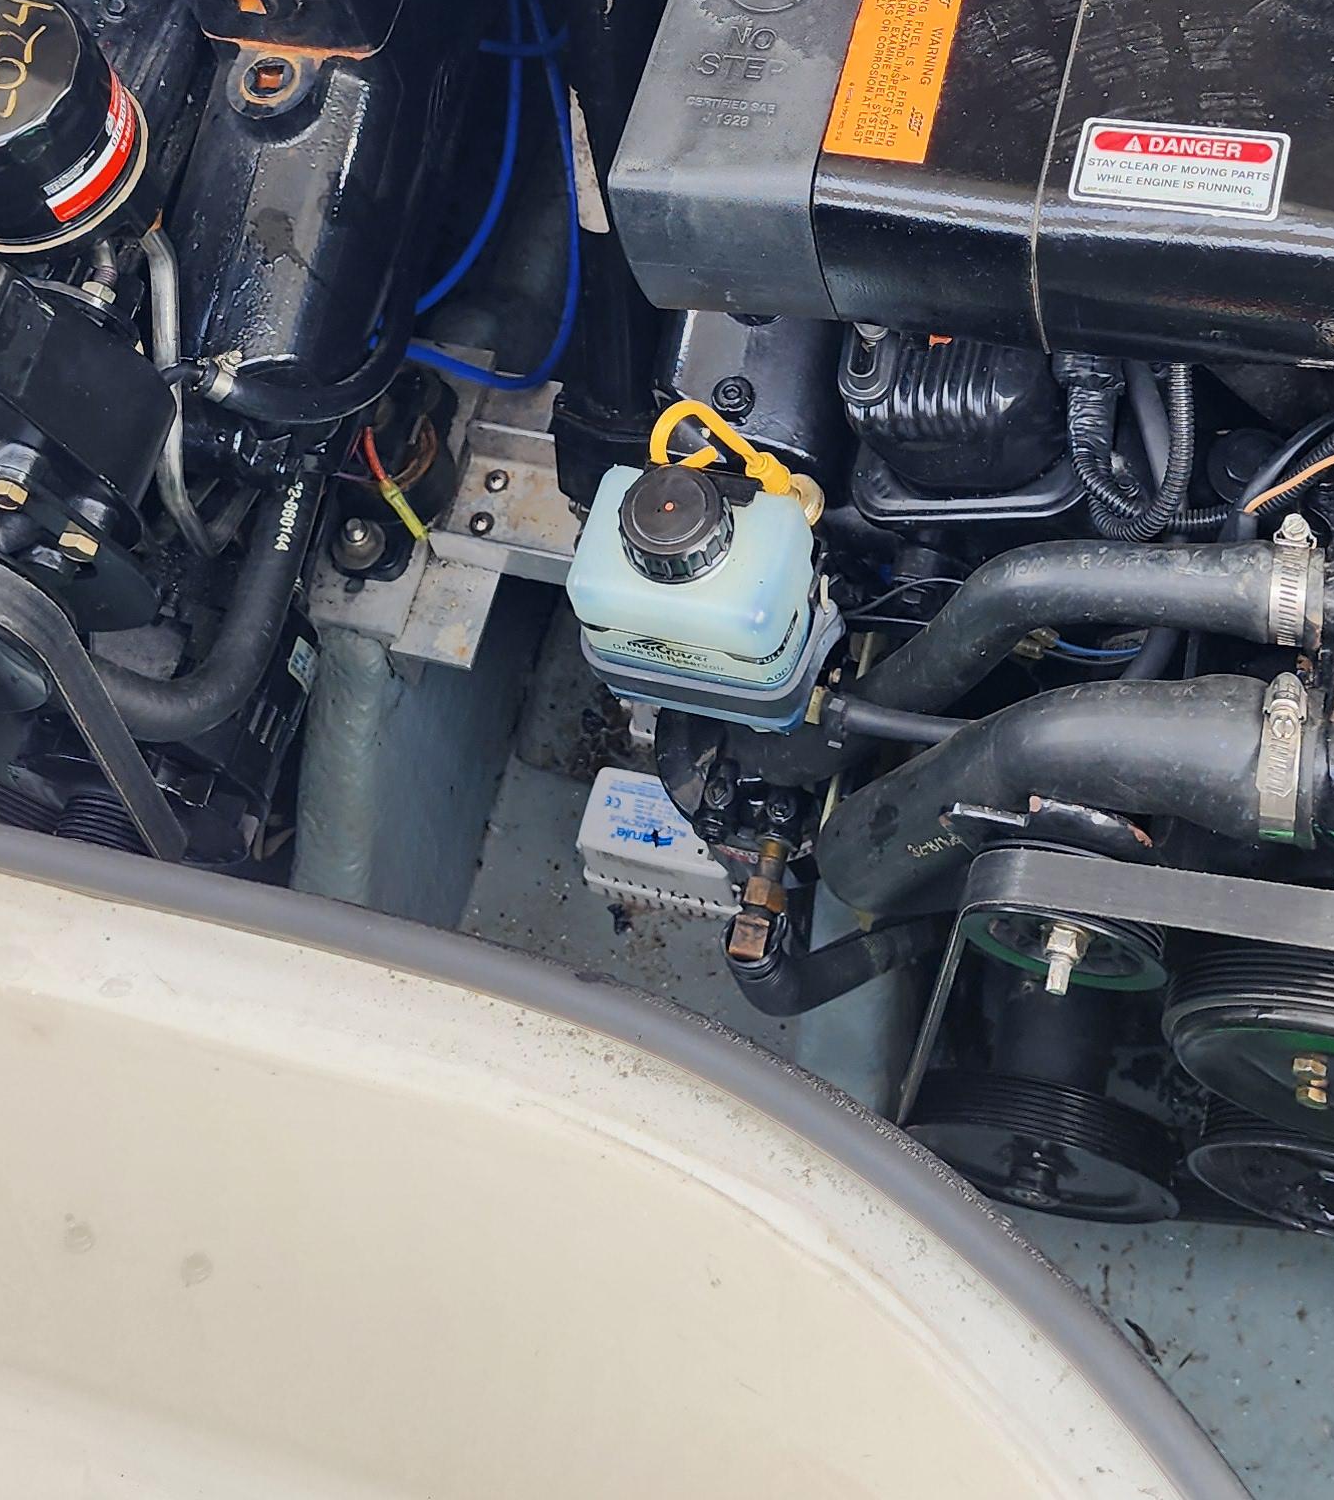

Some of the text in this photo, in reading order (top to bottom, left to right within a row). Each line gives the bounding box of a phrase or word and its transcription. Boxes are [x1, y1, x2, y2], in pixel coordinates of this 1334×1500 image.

[730, 26, 777, 49] NO
[880, 19, 891, 32] OR
[912, 21, 924, 48] FUEL
[697, 52, 787, 81] STEP
[865, 35, 886, 93] CORROSION
[906, 56, 915, 66] IS
[920, 27, 944, 86] WARNING
[863, 27, 896, 144] EXAMINE FUEL SYSTEM
[887, 63, 903, 103] INSPECT
[687, 96, 777, 114] CERTIFIED SAE
[861, 96, 871, 109] AT
[898, 91, 907, 115] FIRE
[852, 112, 867, 143] LEAST
[875, 106, 892, 146] SYSTEM
[886, 123, 899, 147] AND
[1148, 137, 1242, 158] DANGER
[1088, 157, 1270, 181] STAY CLEAR OF MOVING PARTS
[1097, 173, 1132, 184] WHILE
[1136, 176, 1179, 188] ENGINE
[1183, 180, 1195, 189] IS
[612, 643, 725, 672] Drive Oil Reservoir
